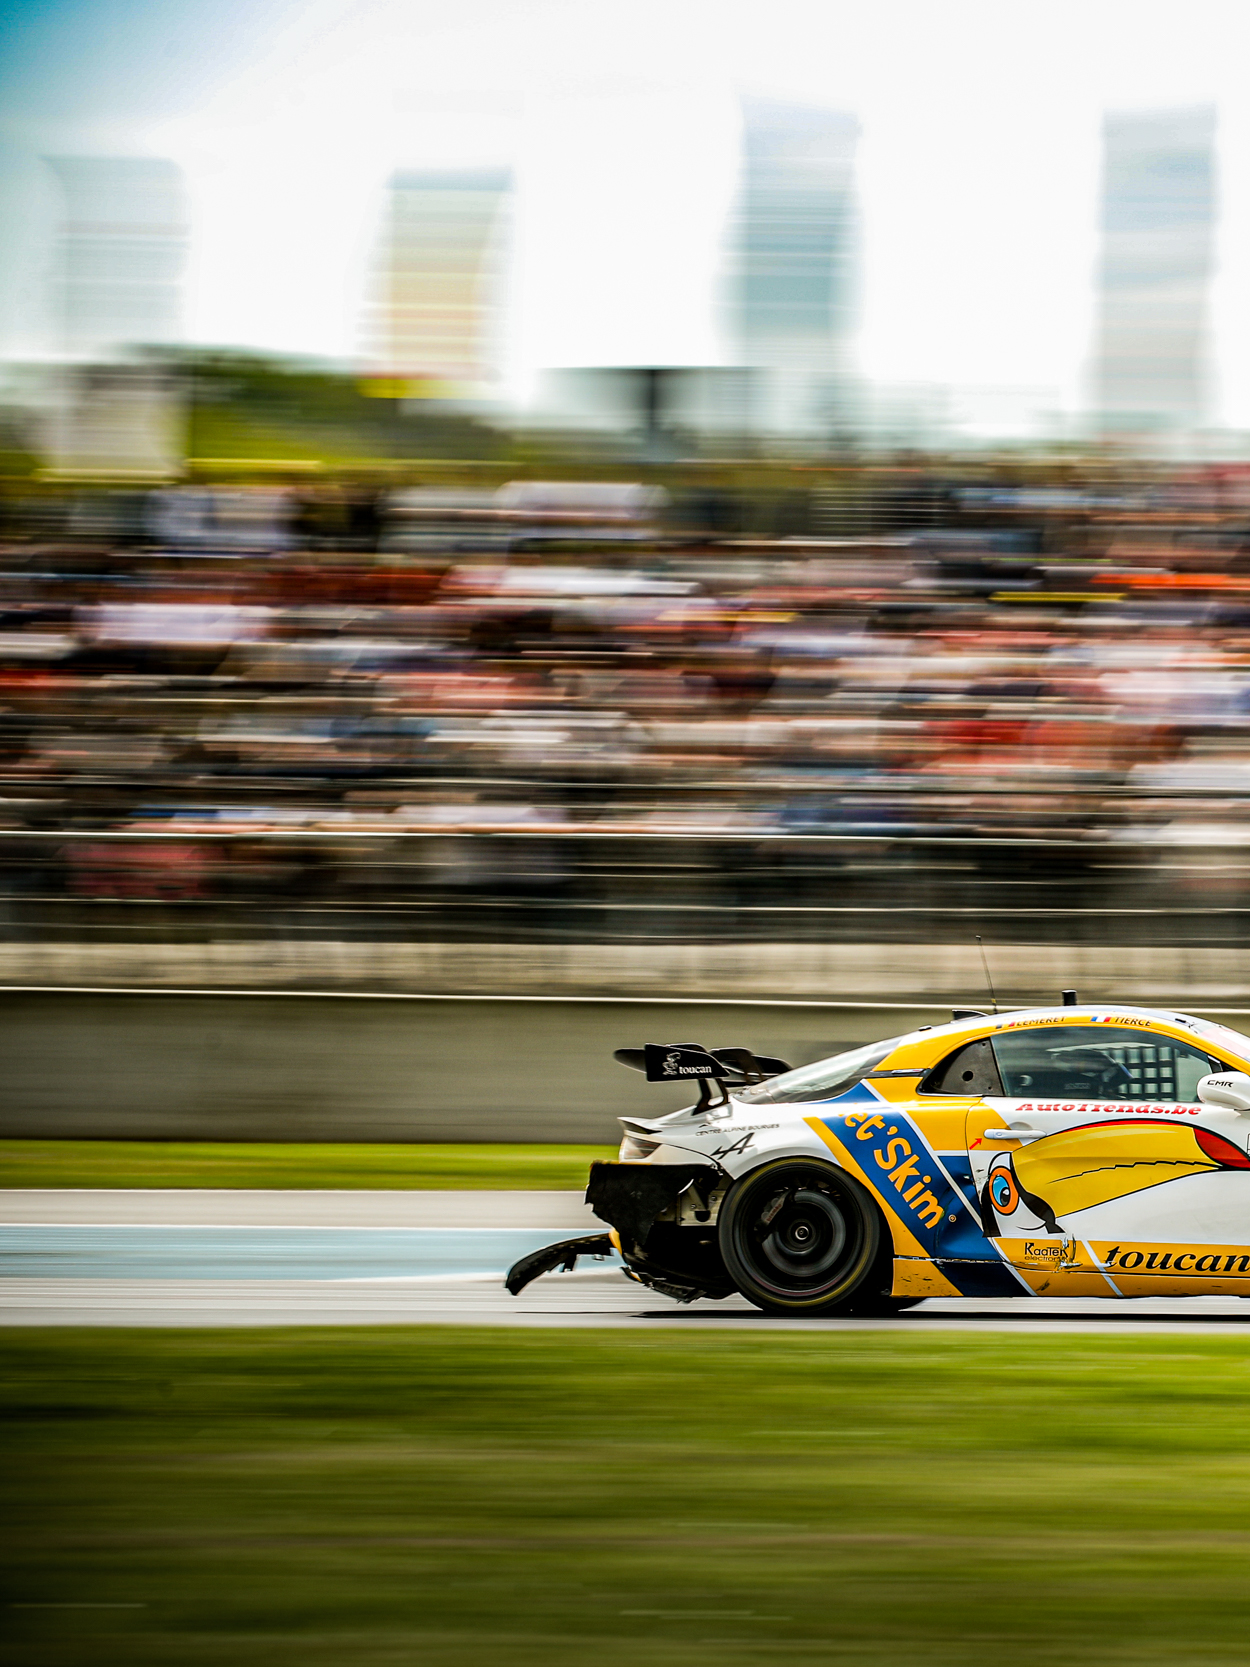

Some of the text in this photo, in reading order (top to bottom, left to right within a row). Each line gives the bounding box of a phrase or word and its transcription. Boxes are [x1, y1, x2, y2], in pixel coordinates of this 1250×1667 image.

[679, 1065, 712, 1075] toucan
[1207, 1079, 1234, 1088] CMR
[1015, 1103, 1202, 1116] AutoTrends.be
[695, 1128, 721, 1137] CENTRE
[747, 1123, 780, 1131] BOURGES
